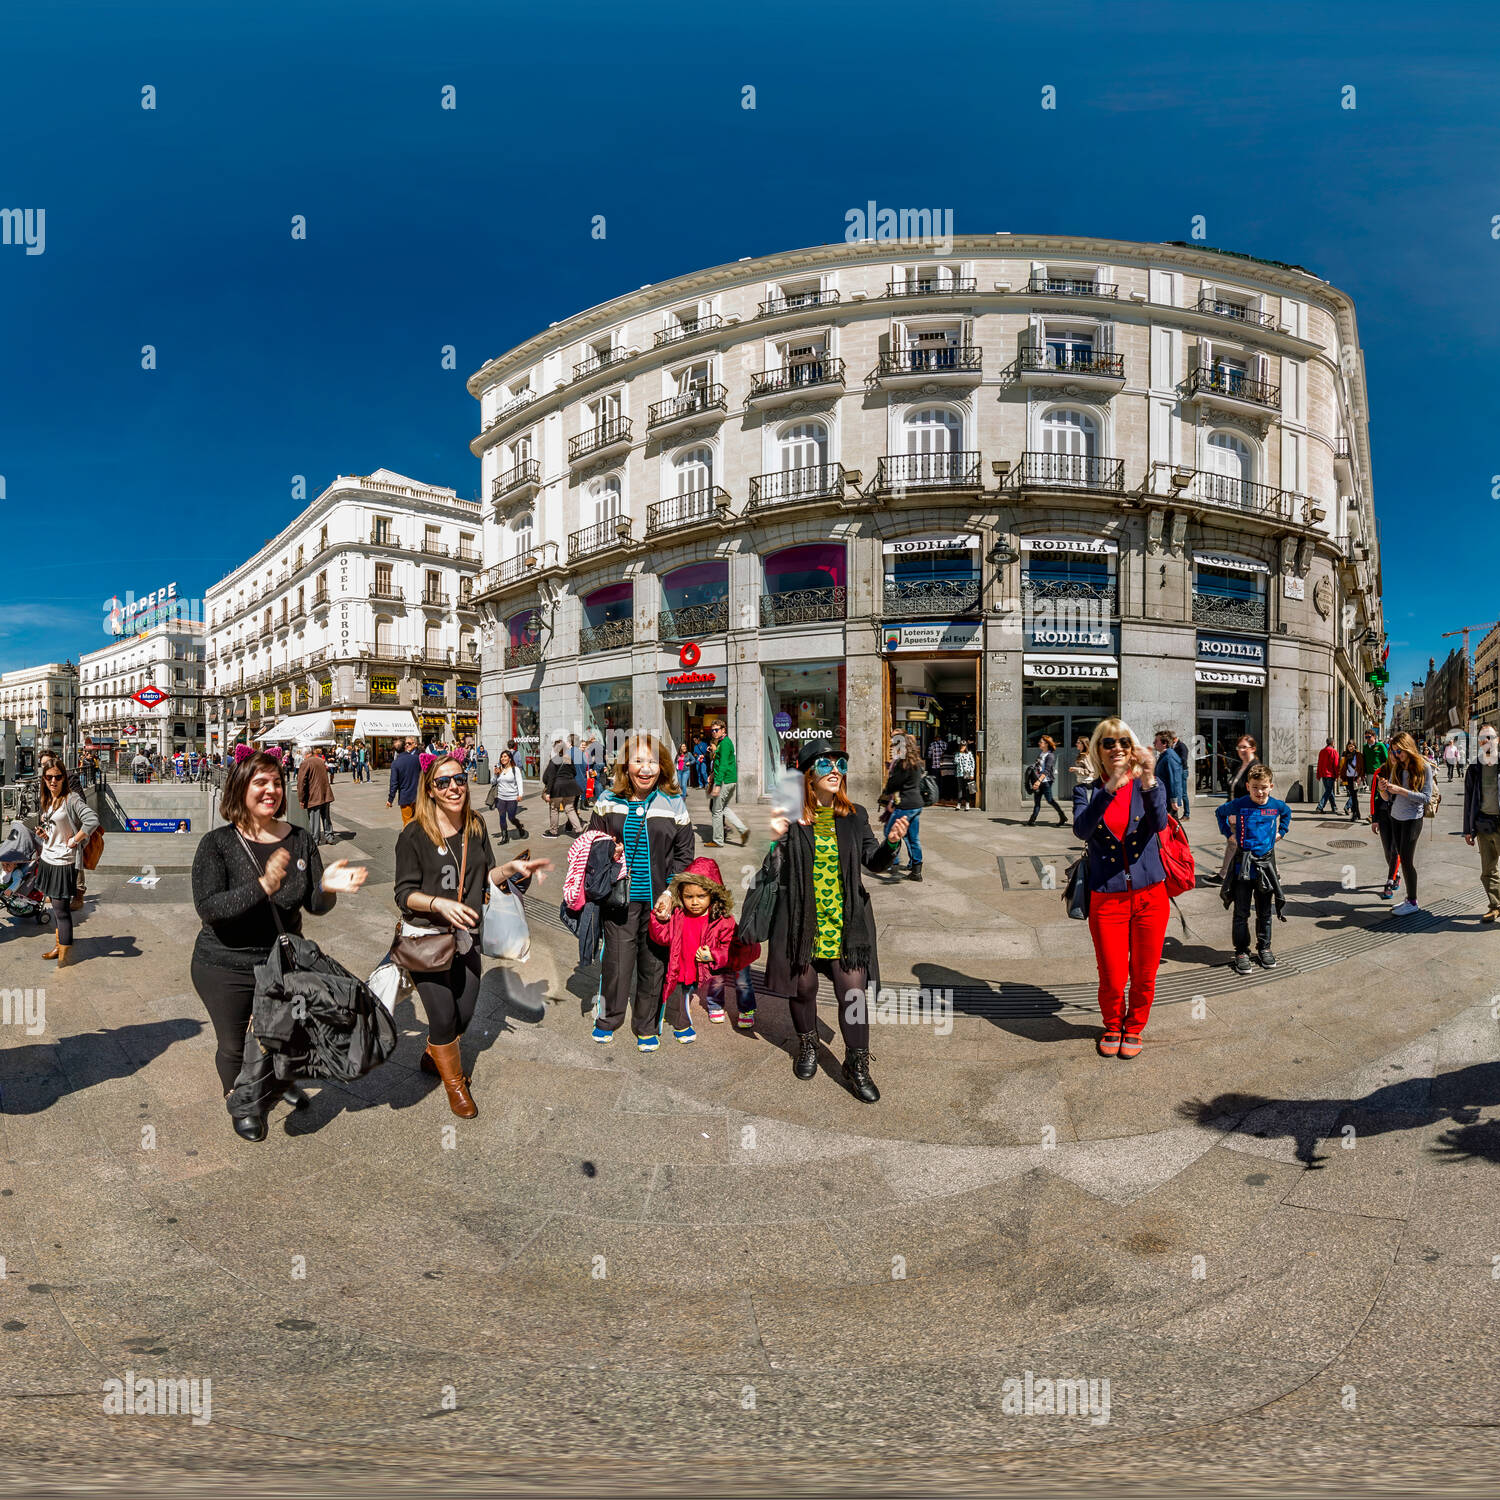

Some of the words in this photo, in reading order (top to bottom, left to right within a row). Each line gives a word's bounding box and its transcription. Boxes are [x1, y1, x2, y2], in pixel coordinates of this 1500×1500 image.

[893, 540, 968, 553] RODILLA
[1032, 541, 1108, 553] RODILLA
[340, 551, 348, 591] HOTEL
[121, 602, 137, 618] TIO
[140, 582, 177, 611] PEPE
[341, 603, 349, 656] EUROPA
[904, 636, 939, 645] Apuestas
[941, 635, 952, 643] del
[953, 634, 980, 643] Estado
[1034, 631, 1110, 645] RODILLA
[1201, 641, 1263, 658] RODILLA
[1033, 665, 1110, 677] RODILLA
[666, 671, 717, 685] vodafone
[371, 681, 397, 690] ORO
[513, 735, 540, 743] vodafone
[779, 728, 833, 739] vodafone
